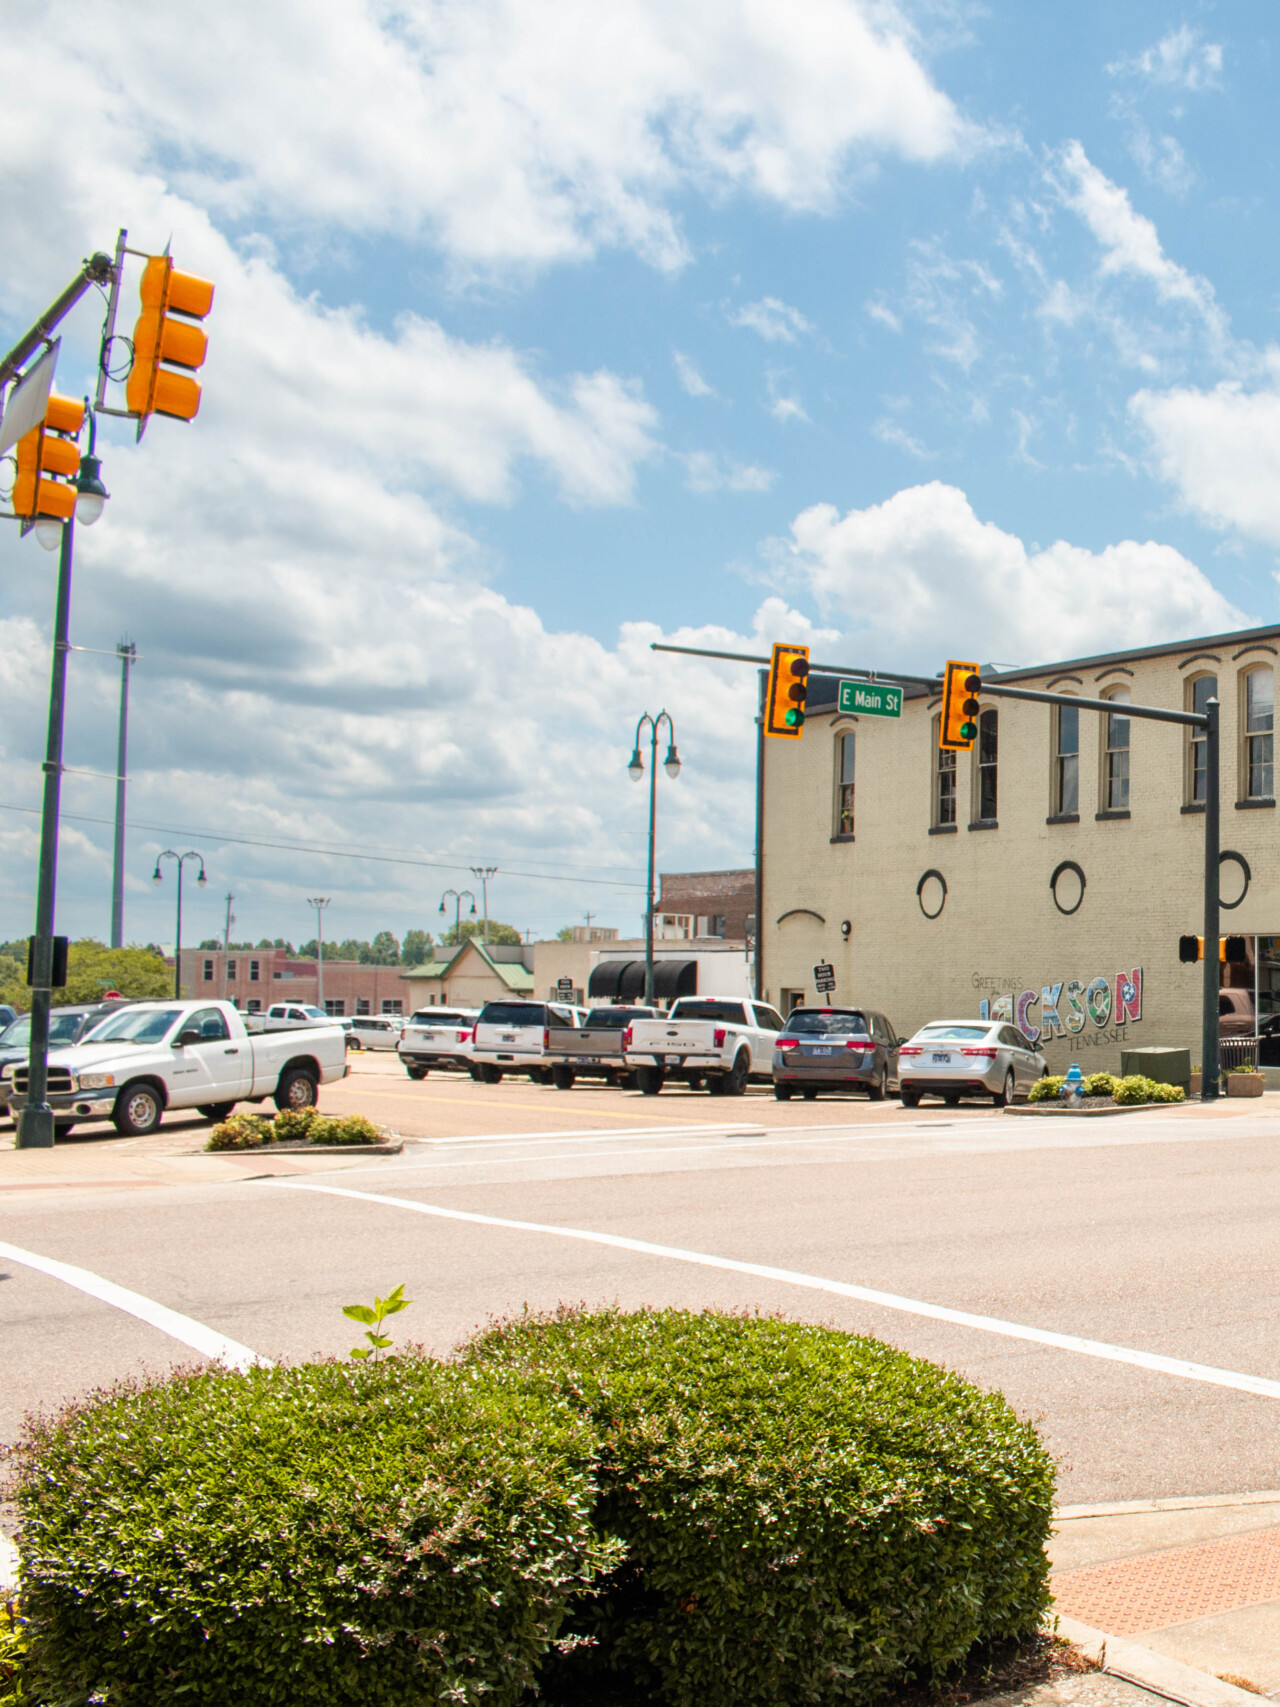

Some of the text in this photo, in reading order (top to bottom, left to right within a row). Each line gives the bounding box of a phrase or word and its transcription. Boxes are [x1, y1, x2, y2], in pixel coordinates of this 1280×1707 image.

[842, 688, 899, 711] E Main St
[1068, 1027, 1131, 1051] TENNESSEE
